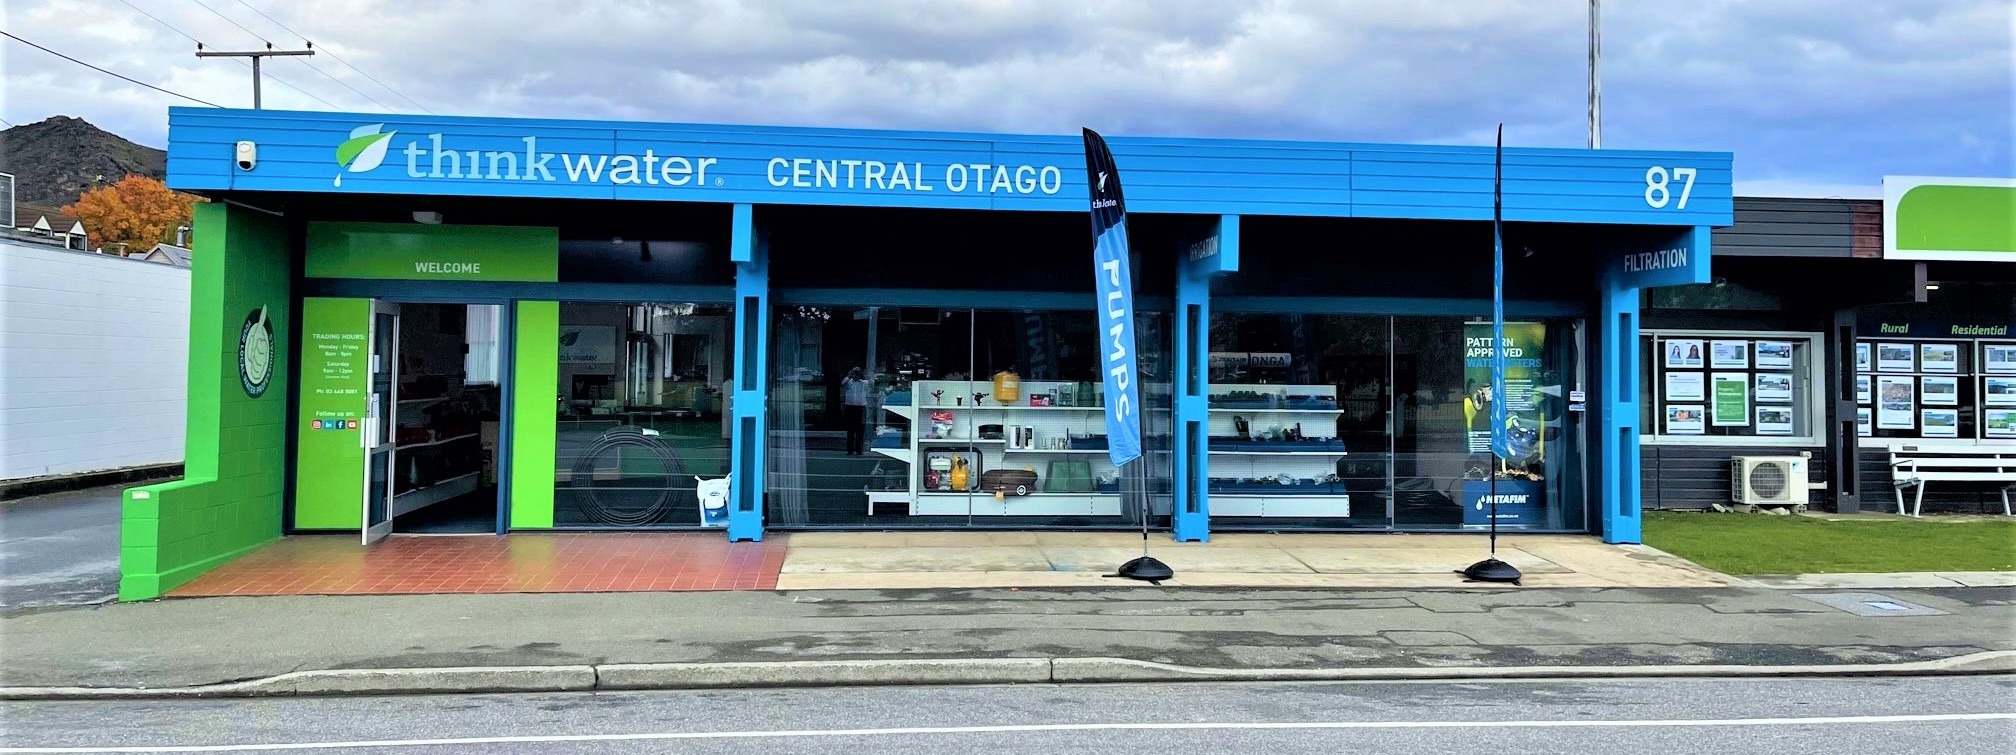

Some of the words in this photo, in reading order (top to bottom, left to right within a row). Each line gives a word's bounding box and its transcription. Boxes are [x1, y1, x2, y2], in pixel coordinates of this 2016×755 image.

[766, 157, 933, 191] CENTRAL
[945, 163, 1062, 195] OTAGO
[1644, 165, 1697, 210] 87
[1624, 247, 1688, 273] FILTRATION
[415, 262, 481, 274] WELCOME
[1880, 323, 1909, 334] Rural
[1951, 324, 2008, 336] Residential
[1102, 258, 1130, 423] PUMPS
[1466, 337, 1514, 347] PATTRN
[1466, 348, 1523, 358] APPRVED
[1466, 359, 1495, 368] WATE
[1485, 494, 1527, 504] NETAFIM
